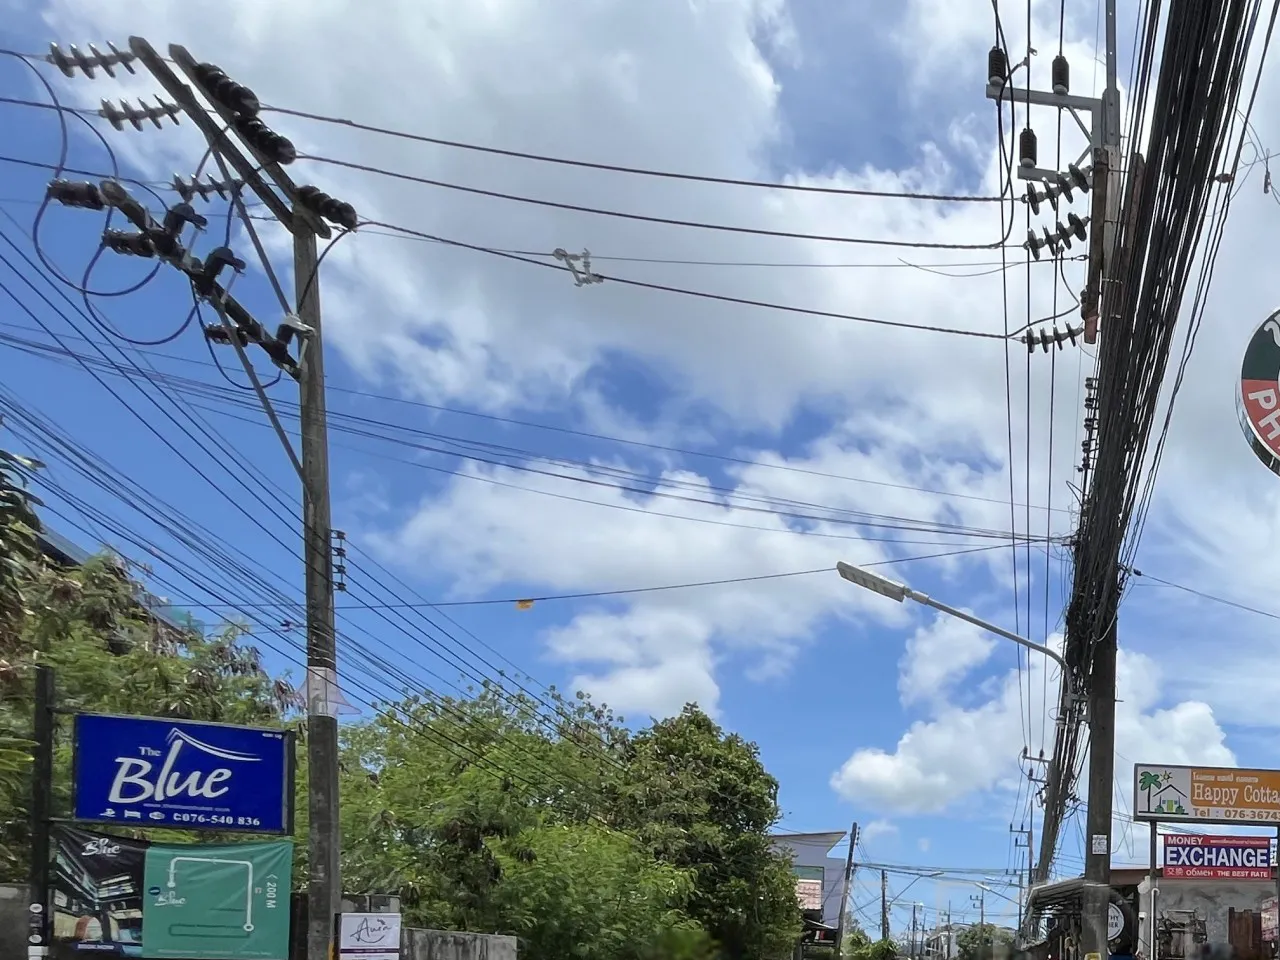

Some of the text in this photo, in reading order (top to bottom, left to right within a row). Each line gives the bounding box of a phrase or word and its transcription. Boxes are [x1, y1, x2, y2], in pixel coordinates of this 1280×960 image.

[138, 746, 162, 757] The
[108, 739, 232, 804] Blue
[1193, 782, 1239, 805] Happy
[1193, 808, 1210, 817] Tel
[181, 813, 261, 826] 076-540 836
[1168, 836, 1204, 845] MONEY
[1166, 847, 1268, 867] EXCHANGE
